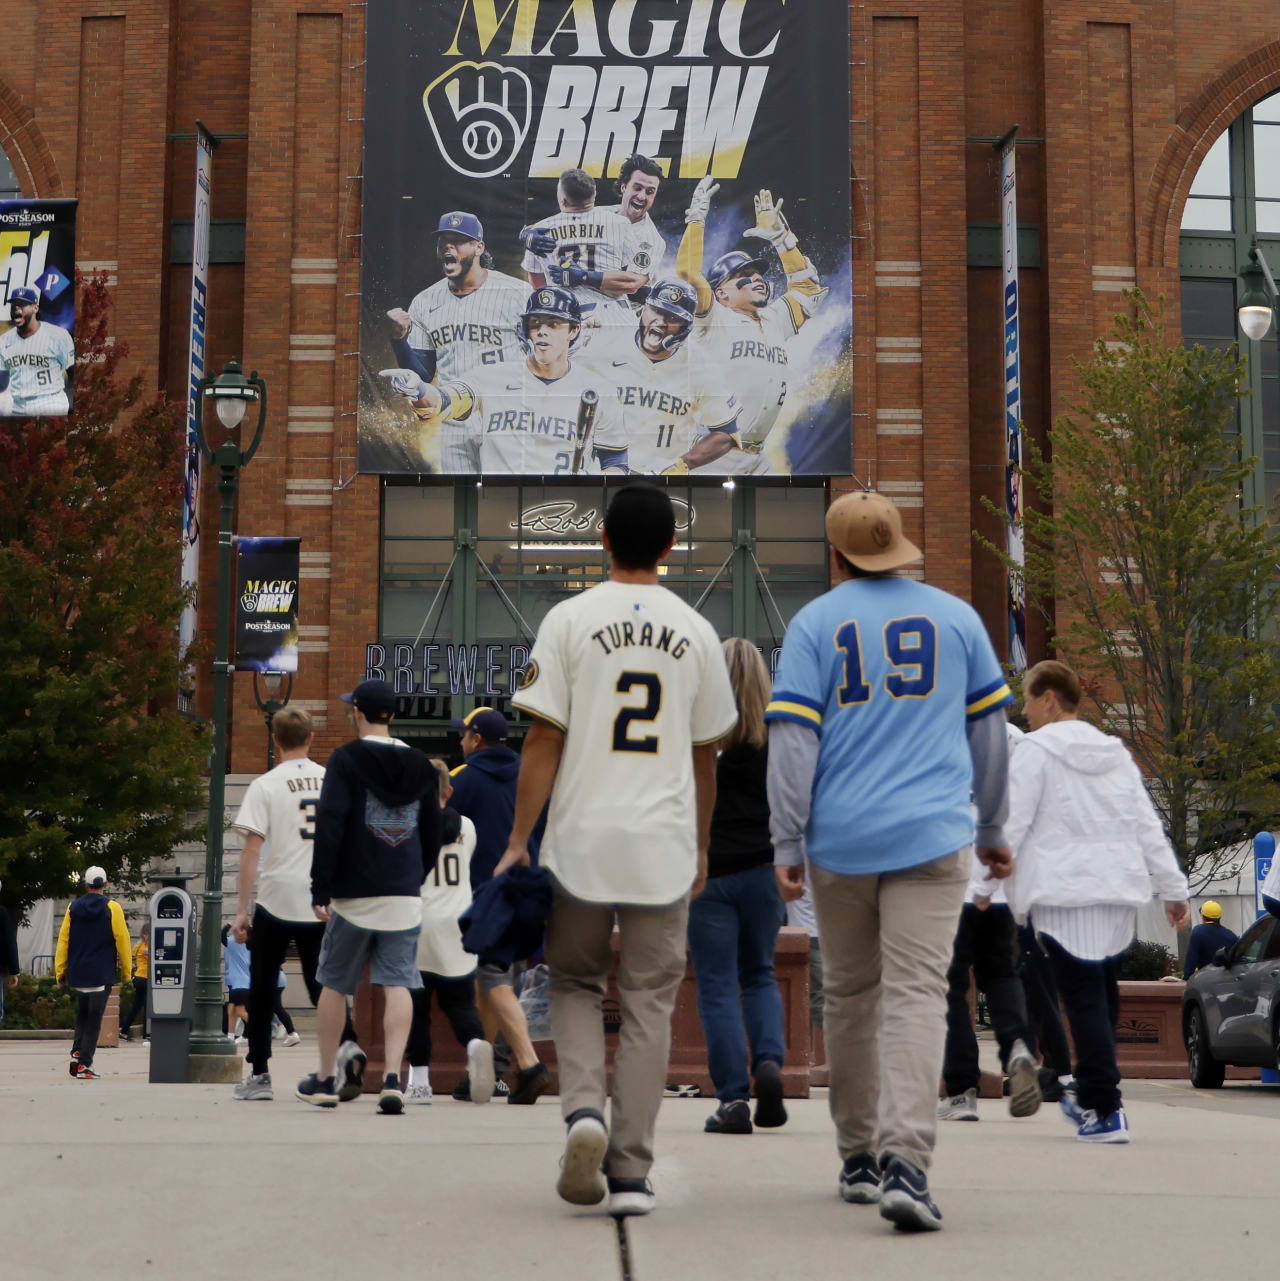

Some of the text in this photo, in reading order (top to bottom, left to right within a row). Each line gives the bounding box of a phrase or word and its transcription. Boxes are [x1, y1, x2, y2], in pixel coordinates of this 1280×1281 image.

[528, 64, 769, 179] BREW
[550, 223, 605, 241] DURBIN
[431, 322, 503, 348] REWERS
[730, 340, 788, 366] BREWER
[36, 370, 53, 386] 51
[616, 386, 691, 416] EWERS
[487, 409, 576, 440] BREWER
[655, 424, 675, 448] 11
[244, 580, 297, 594] MAGIC
[256, 593, 294, 613] BREW
[245, 622, 291, 630] POSTSEASON
[591, 621, 690, 660] TURANG
[366, 644, 532, 695] BREWER
[833, 614, 939, 709] 19
[611, 670, 664, 755] 2
[286, 776, 324, 793] ORTI
[298, 798, 321, 840] 3
